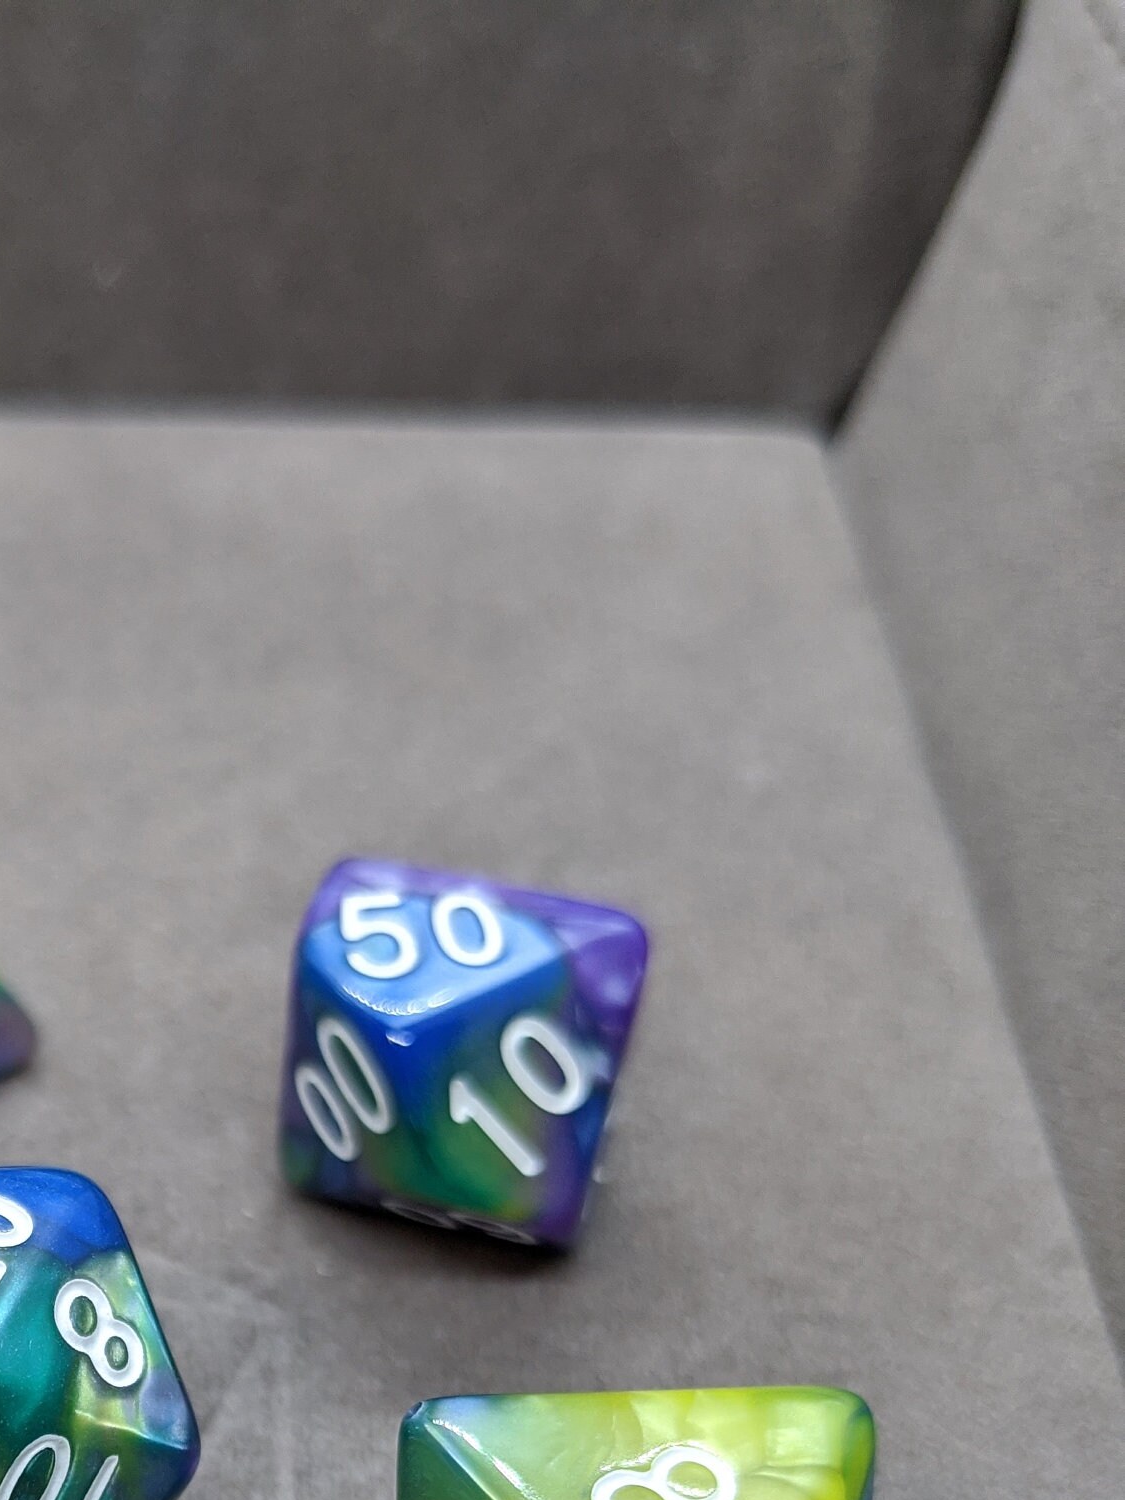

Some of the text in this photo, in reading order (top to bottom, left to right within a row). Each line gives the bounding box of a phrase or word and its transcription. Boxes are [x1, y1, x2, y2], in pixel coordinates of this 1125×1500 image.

[340, 892, 503, 979] 50
[296, 1019, 393, 1161] 00
[450, 1017, 584, 1176] 10
[54, 1278, 144, 1388] 8
